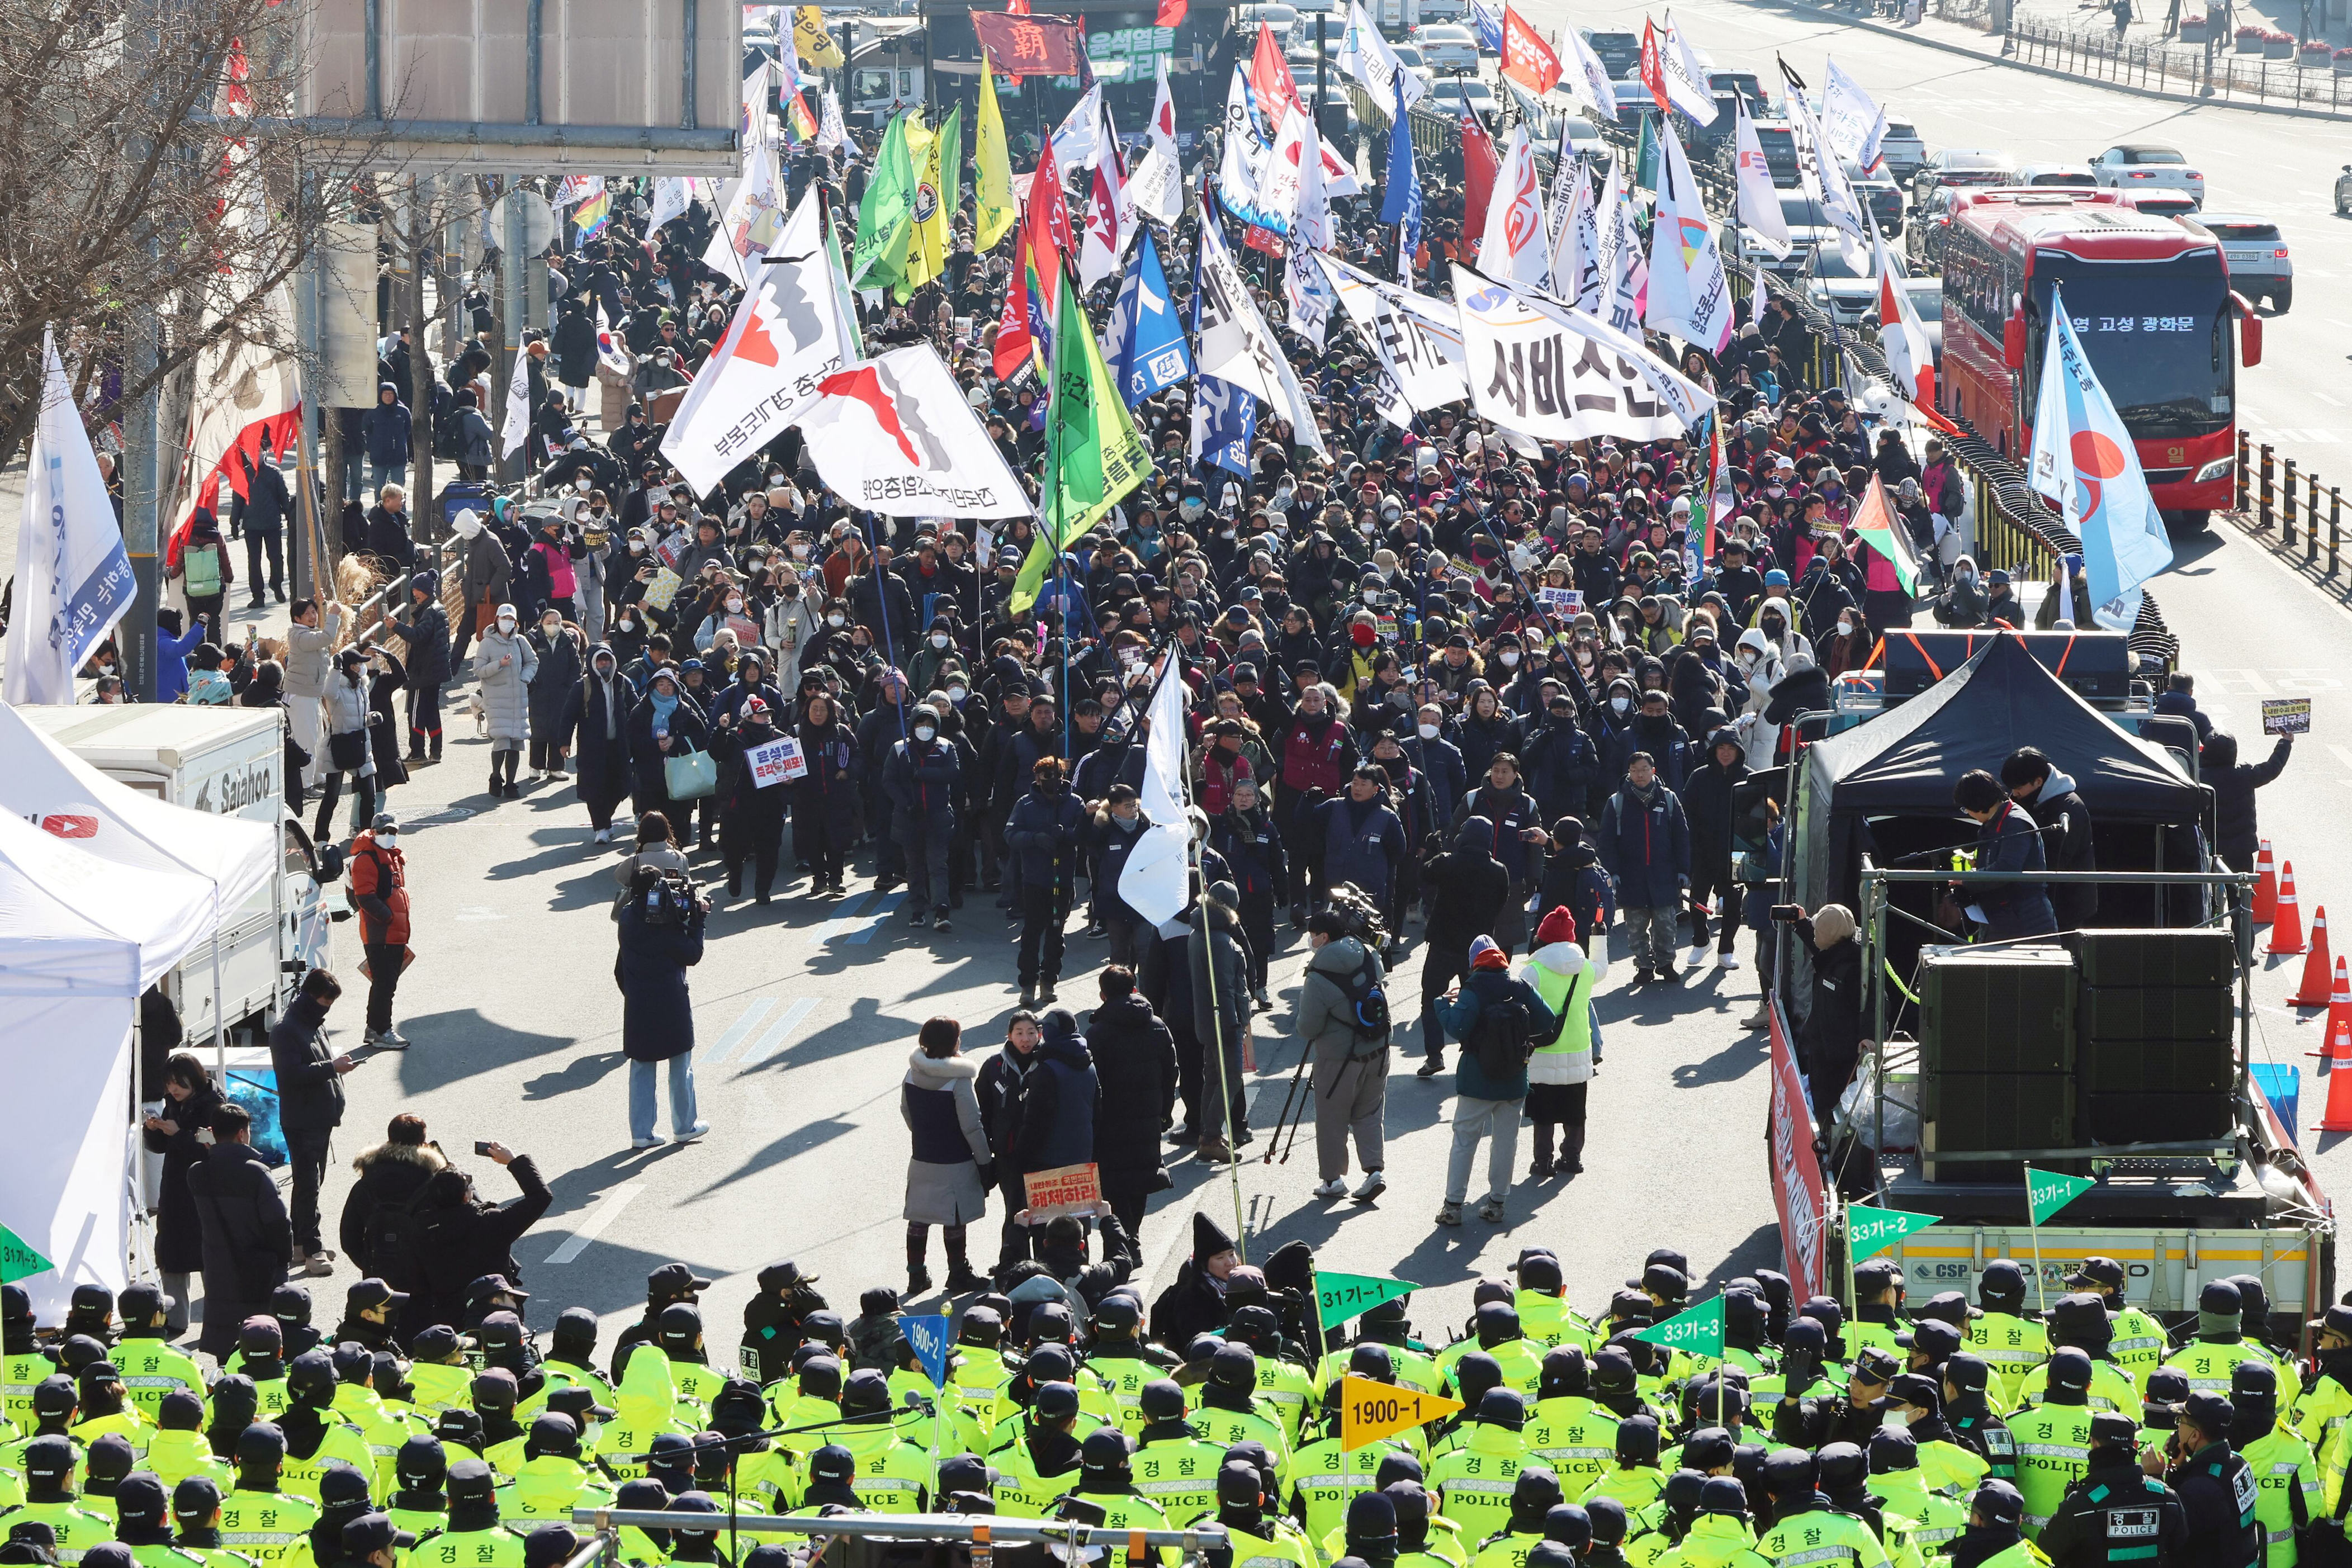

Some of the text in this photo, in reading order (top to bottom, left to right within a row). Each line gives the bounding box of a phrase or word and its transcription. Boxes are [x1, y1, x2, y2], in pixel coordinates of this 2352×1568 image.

[1088, 26, 1175, 55] 윤석열을
[2072, 316, 2194, 333] 영 고성 광화문
[1487, 333, 1676, 420] 서비스연
[1545, 590, 1577, 603] 윤석열
[2268, 705, 2307, 715] 내란수괴 윤석열
[756, 743, 795, 764] 윤석열
[782, 755, 804, 771] 체포!
[1029, 1178, 1059, 1191] 내란동조
[2032, 1179, 2073, 1207] 33기-1
[1030, 1186, 1098, 1207] 해체하라
[1849, 1216, 1909, 1243] 33기-2
[3, 1245, 39, 1270] 31기-3
[1935, 1264, 1968, 1277] CSP
[1323, 1282, 1385, 1308] 31기-1
[1664, 1319, 1720, 1342] 33기-3
[1975, 1329, 2022, 1345] 경찰
[912, 1321, 939, 1360] 1900-2
[2117, 1352, 2157, 1365] OLICE
[13, 1363, 30, 1380] 찰
[1352, 1398, 1421, 1425] 1900-1
[1196, 1421, 1246, 1441] 경찰
[1536, 1427, 1585, 1443] 경찰
[2037, 1423, 2089, 1443] 경찰
[1144, 1458, 1195, 1477] 경찰
[1324, 1453, 1376, 1470] 경찰
[1466, 1458, 1517, 1476] 경찰
[1554, 1463, 1597, 1474] LICE
[2026, 1458, 2090, 1474] POLIC
[281, 1469, 326, 1480] OLIC
[859, 1495, 898, 1505] LICE
[1152, 1495, 1208, 1507] OLICE
[1454, 1494, 1510, 1507] POLIC
[224, 1510, 278, 1528] 경찰
[2113, 1512, 2153, 1526] 경찰
[2114, 1526, 2152, 1534] POLICE
[1771, 1528, 1821, 1551] 경찰
[440, 1545, 495, 1562] 경찰
